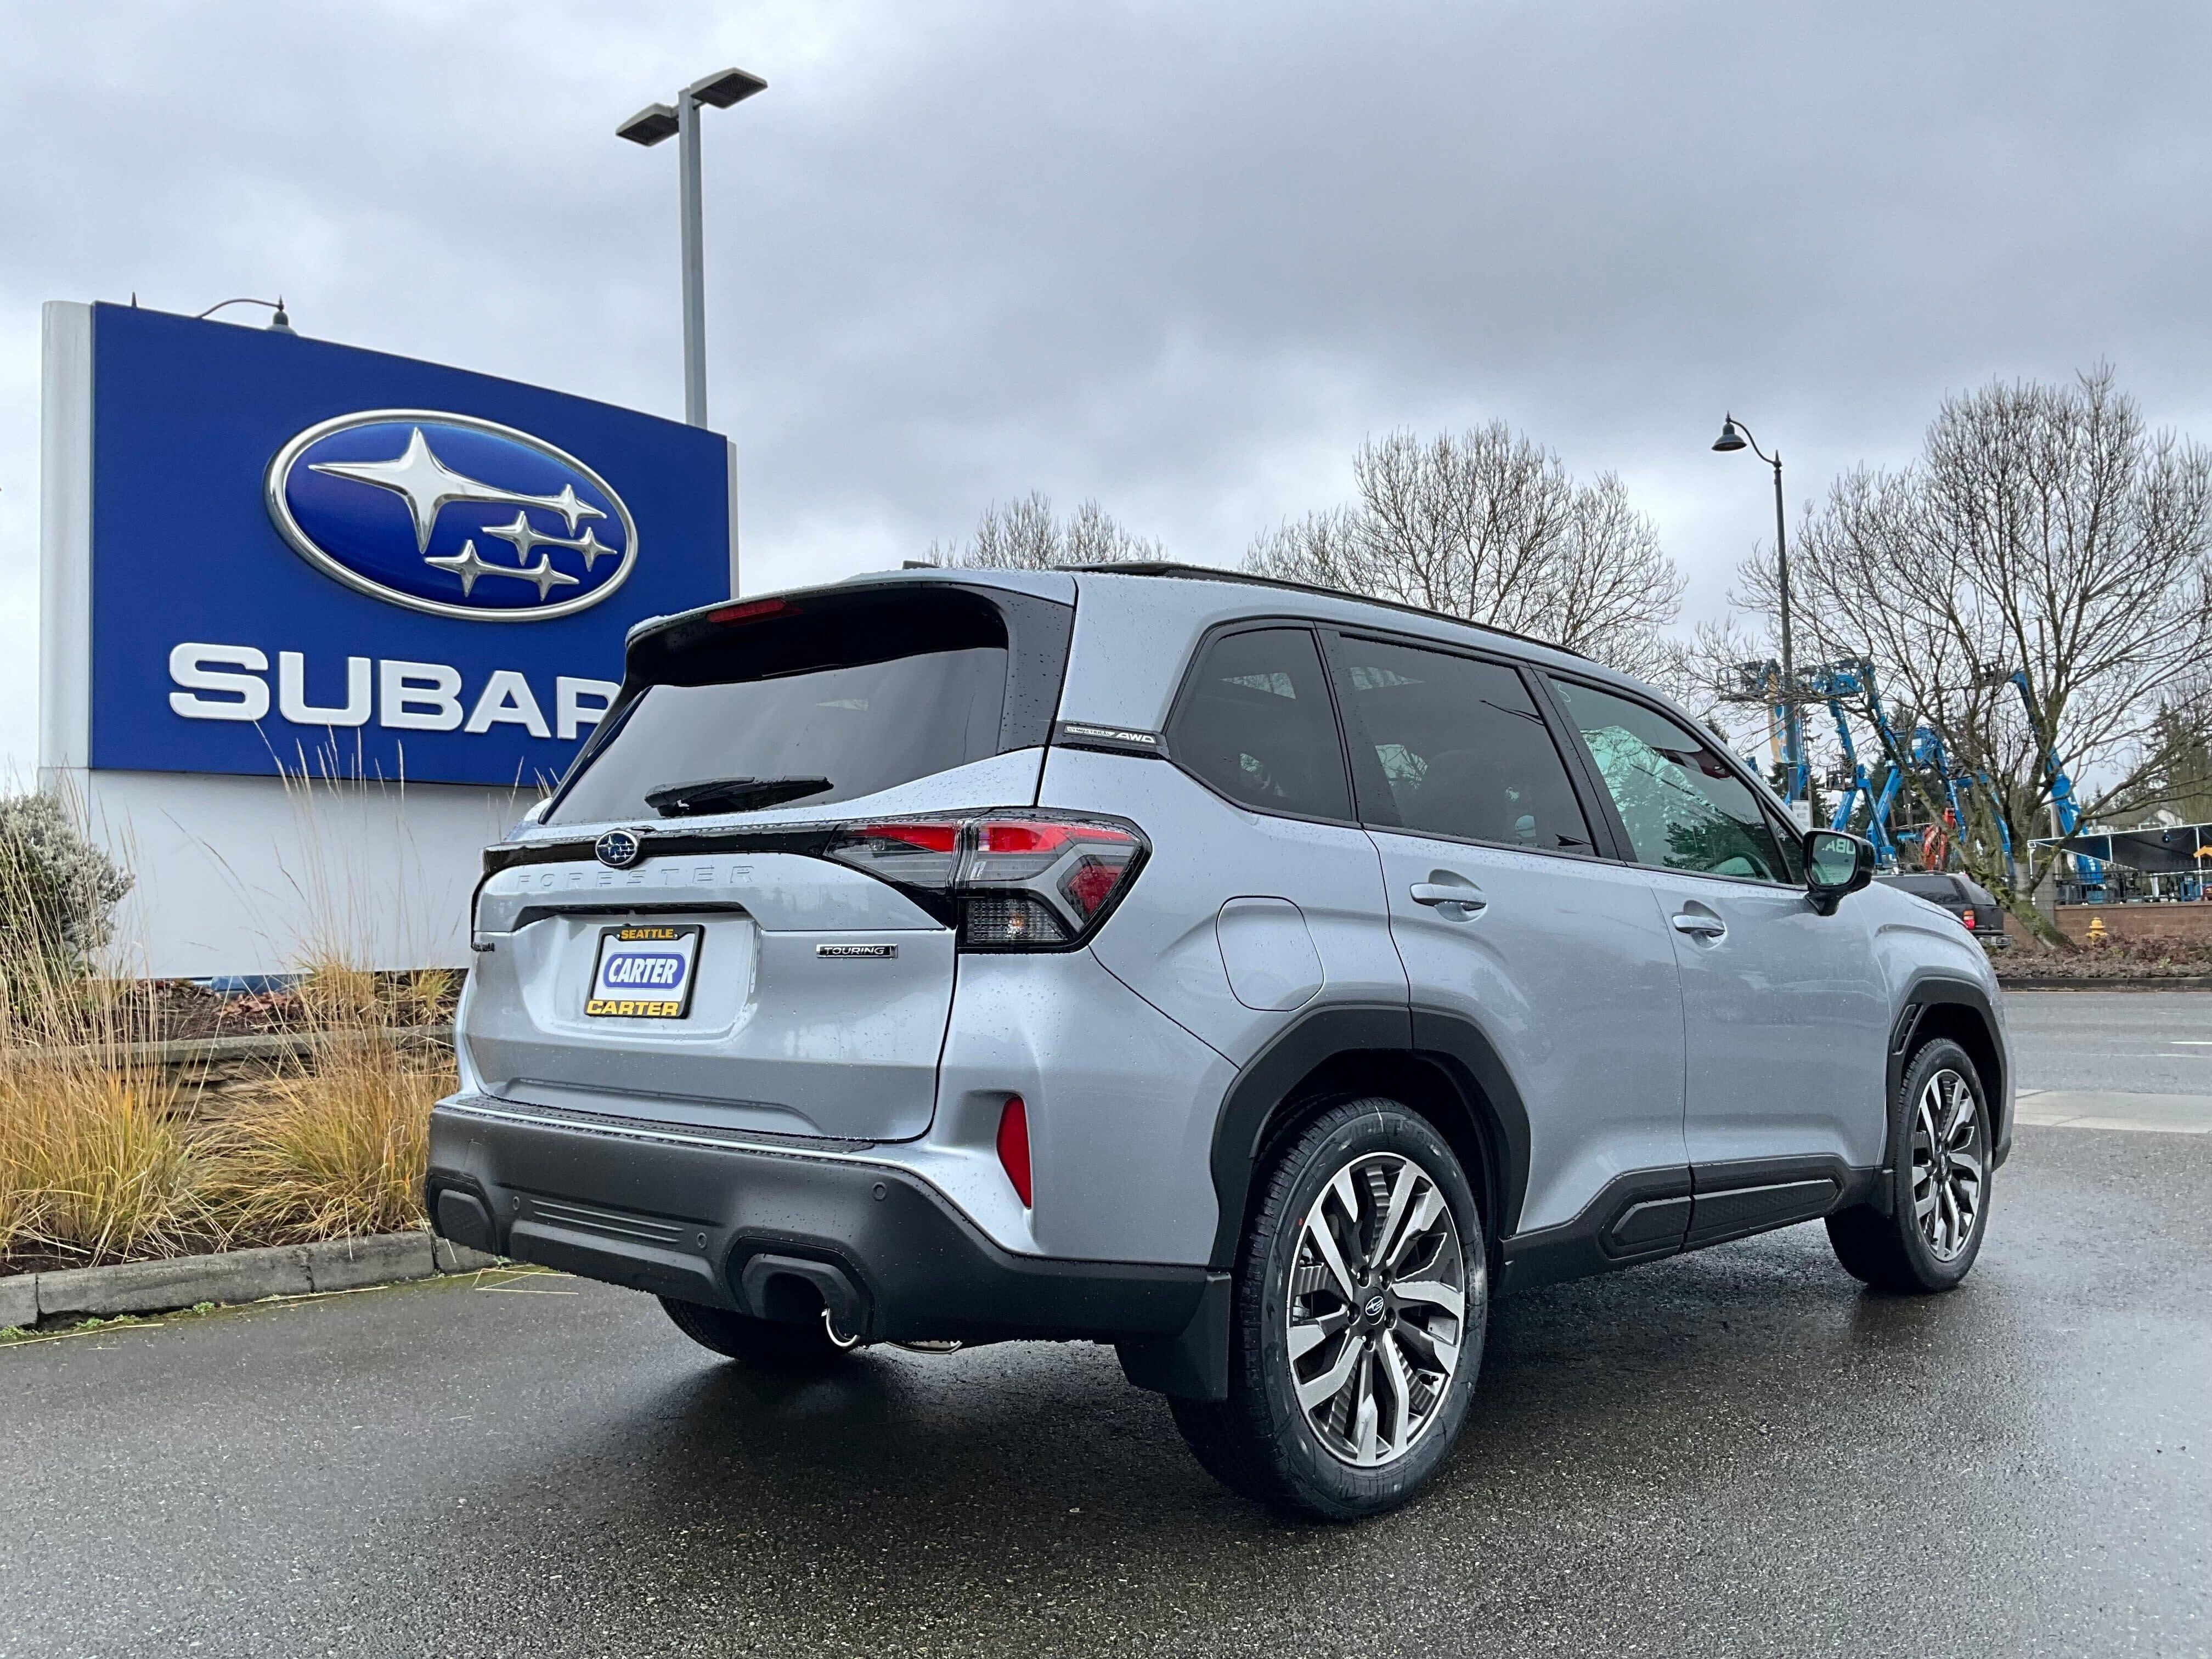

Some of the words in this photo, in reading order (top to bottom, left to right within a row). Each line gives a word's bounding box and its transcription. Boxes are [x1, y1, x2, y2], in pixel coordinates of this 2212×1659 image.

[170, 642, 624, 740] SUBAR
[1068, 727, 1111, 736] SYMMETRICAL
[1115, 732, 1155, 743] AWD
[517, 865, 755, 888] FORESTER
[621, 929, 674, 940] SEATTLE
[608, 957, 678, 984] CARTER
[586, 1000, 679, 1016] CARTER
